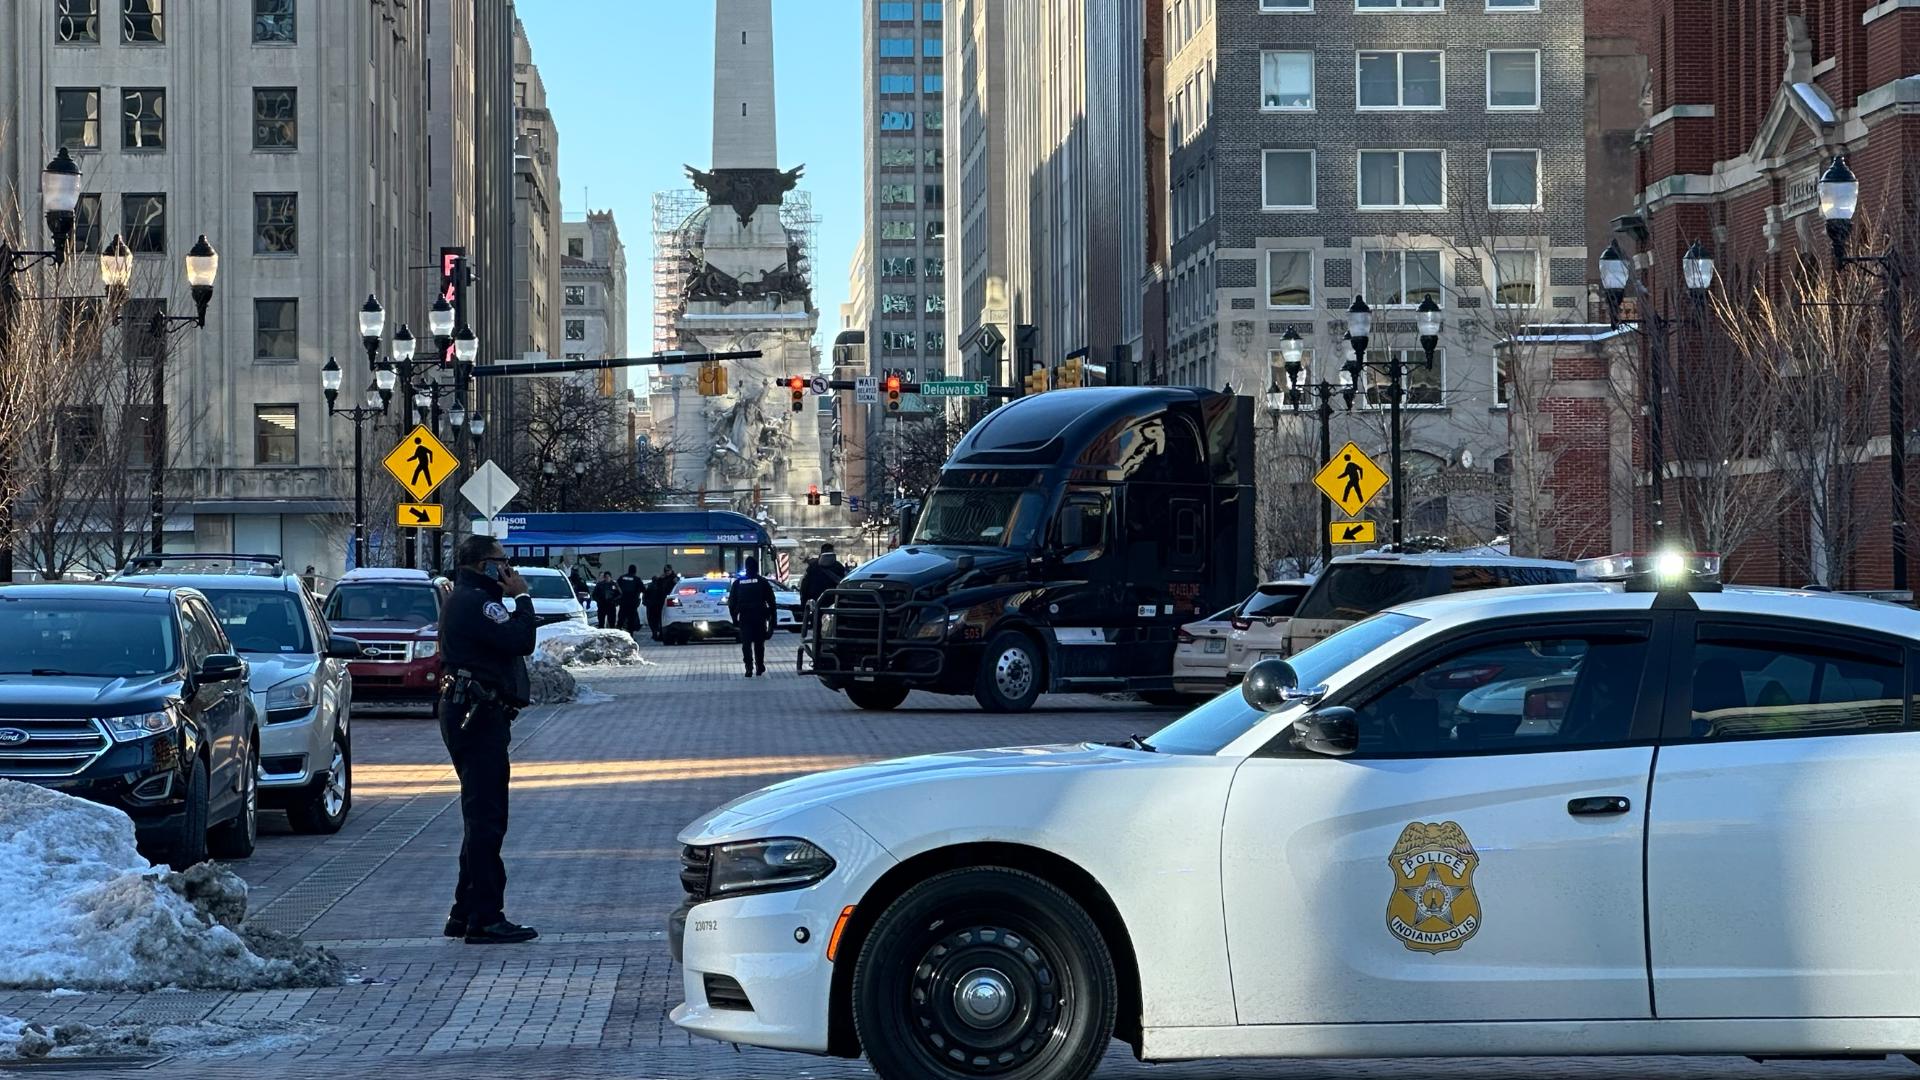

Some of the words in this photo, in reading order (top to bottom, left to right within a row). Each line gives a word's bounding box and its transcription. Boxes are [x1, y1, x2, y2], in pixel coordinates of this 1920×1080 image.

[858, 378, 876, 387] WAIT
[923, 383, 970, 395] Delaware
[974, 383, 985, 395] St
[1406, 852, 1463, 869] POLICE
[1393, 919, 1475, 942] INDIANAPOLIS
